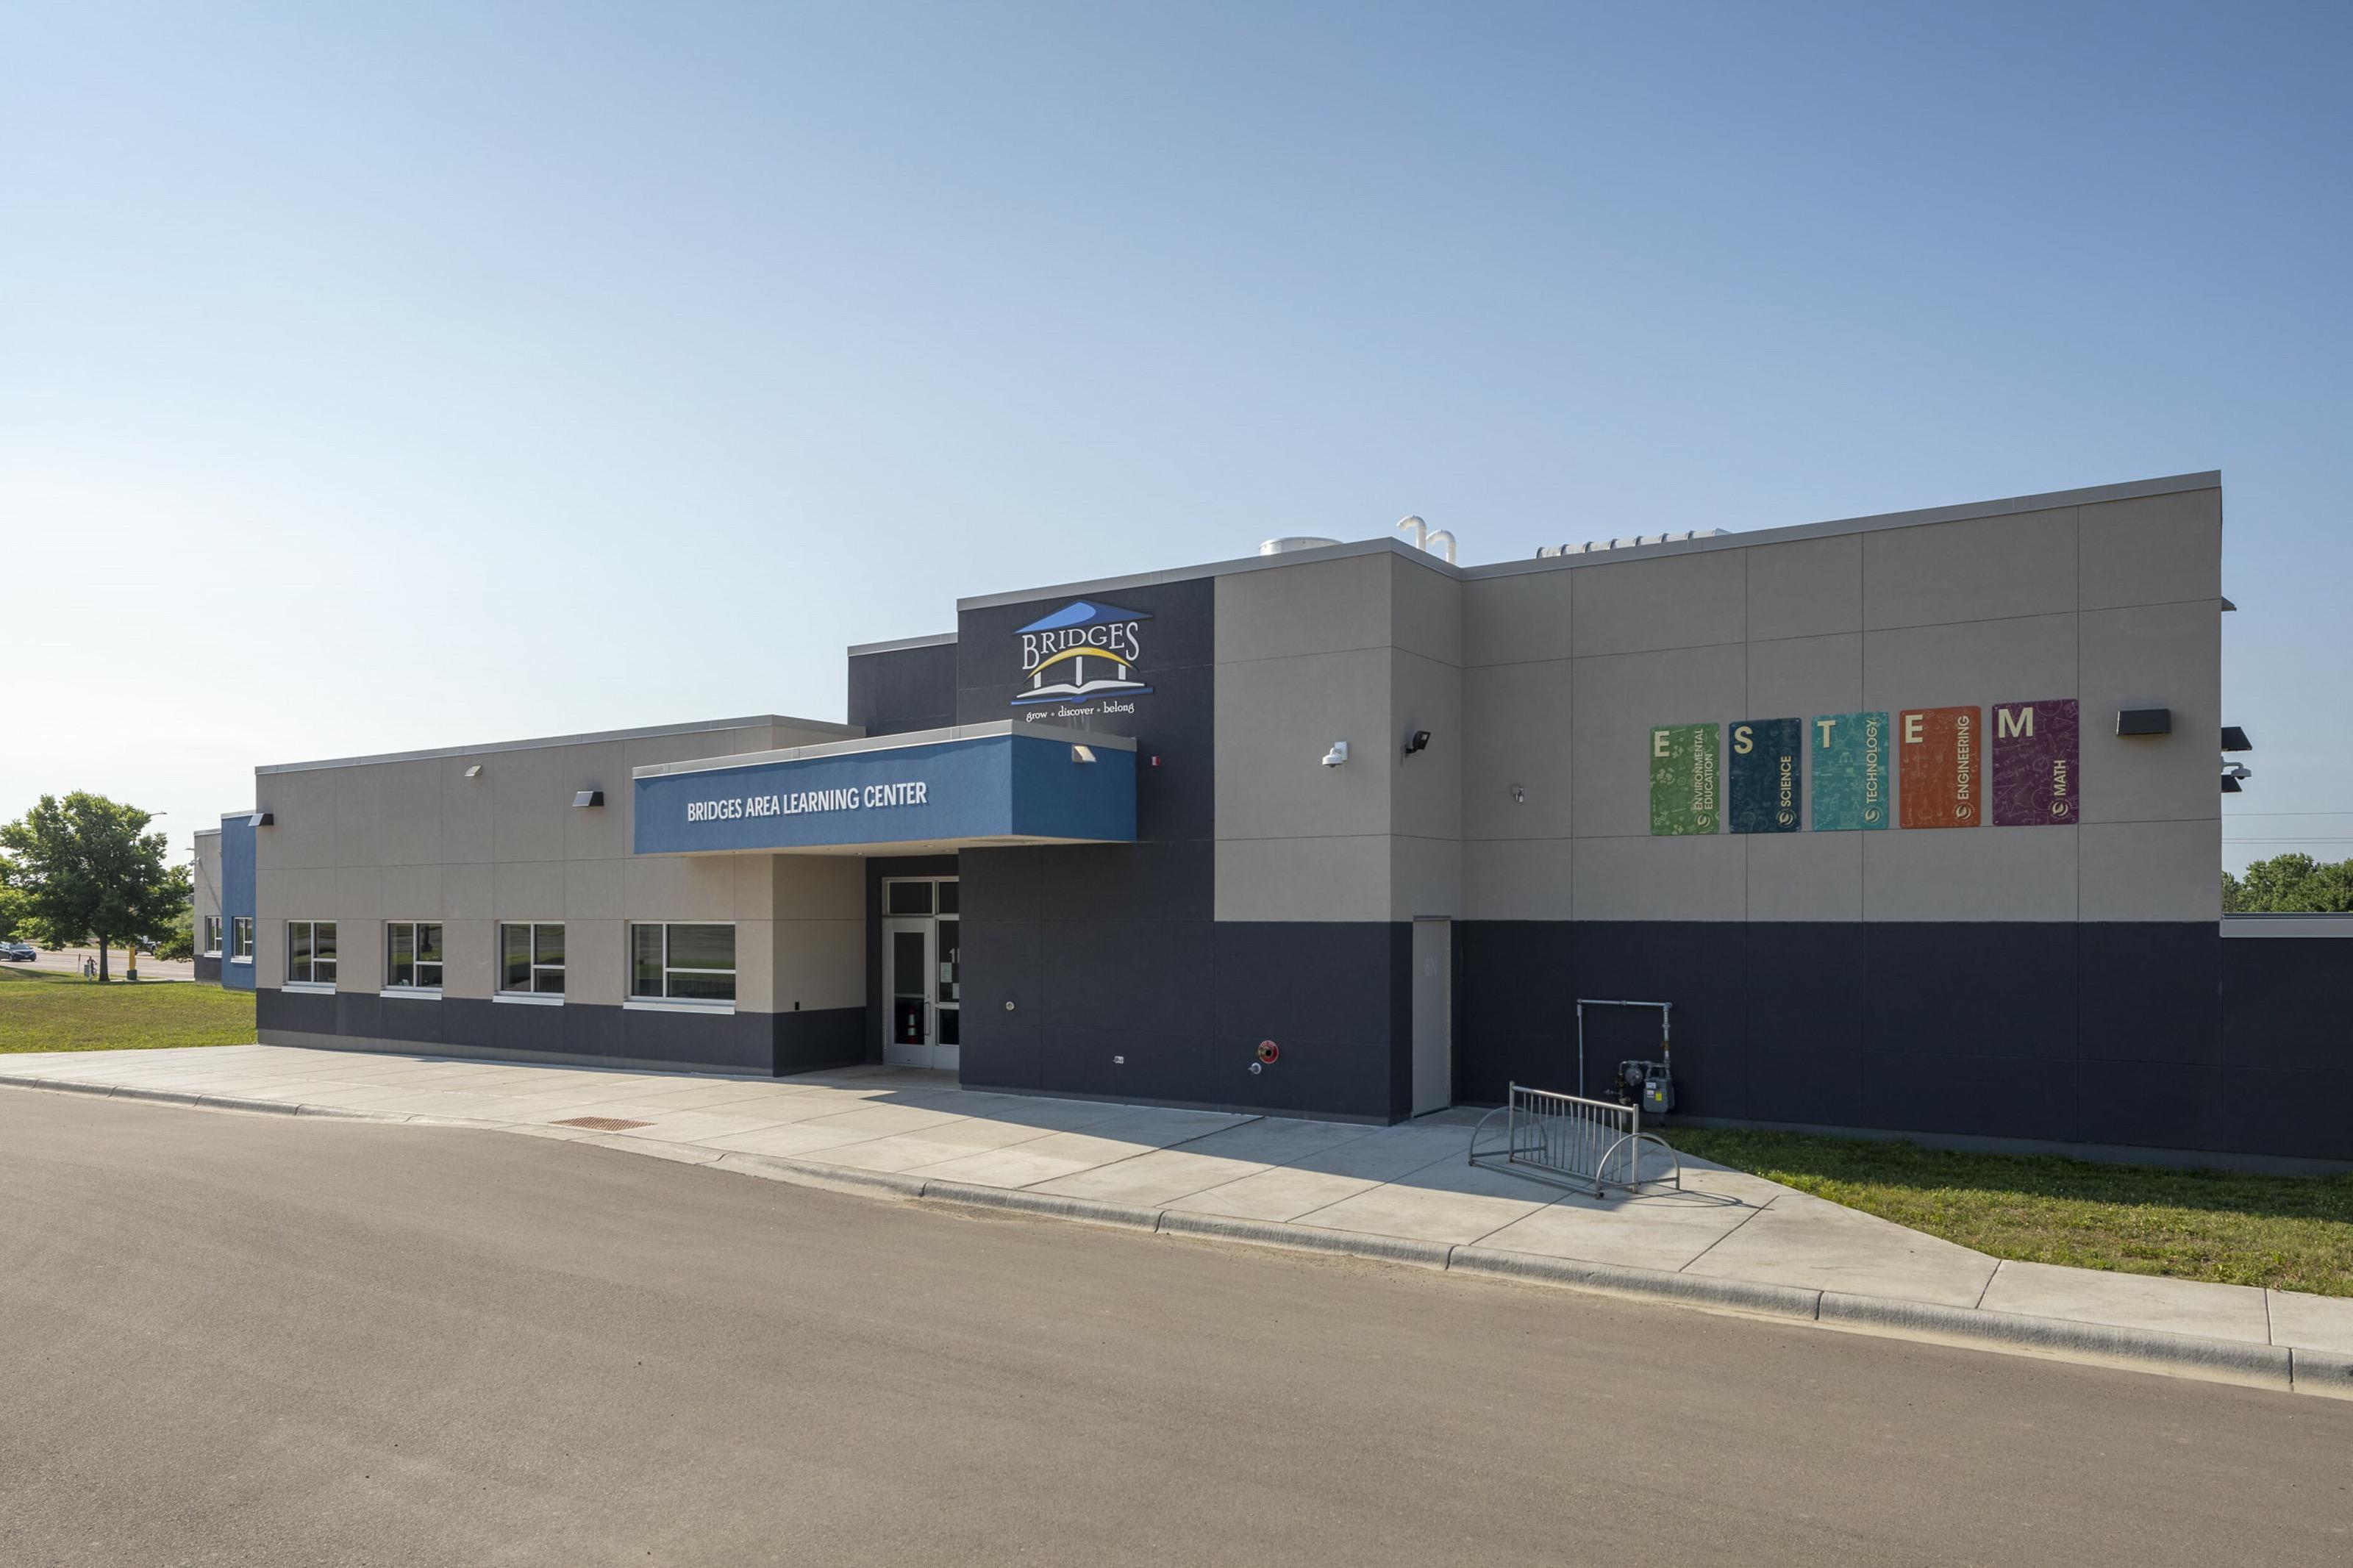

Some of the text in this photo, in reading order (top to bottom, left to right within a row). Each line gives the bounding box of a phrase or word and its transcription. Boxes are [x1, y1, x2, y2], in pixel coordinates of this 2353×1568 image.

[1022, 622, 1140, 670] BRIDGES
[1026, 701, 1135, 722] grow discover belong
[1905, 715, 1924, 743] E
[1998, 707, 2034, 738] M
[1654, 731, 1670, 757] E
[1734, 726, 1754, 754] S
[1817, 720, 1836, 748] T
[1694, 728, 1704, 810] ENVIRONMENTAL
[1866, 719, 1878, 804] TECHNOLOGY
[1957, 715, 1970, 800] ENGINEERING
[1704, 753, 1713, 810] EDUCATION
[1780, 756, 1791, 807] SCIENCE
[2054, 759, 2066, 796] MATH
[688, 781, 927, 822] BRIDGES AREA LEARNING CENTER
